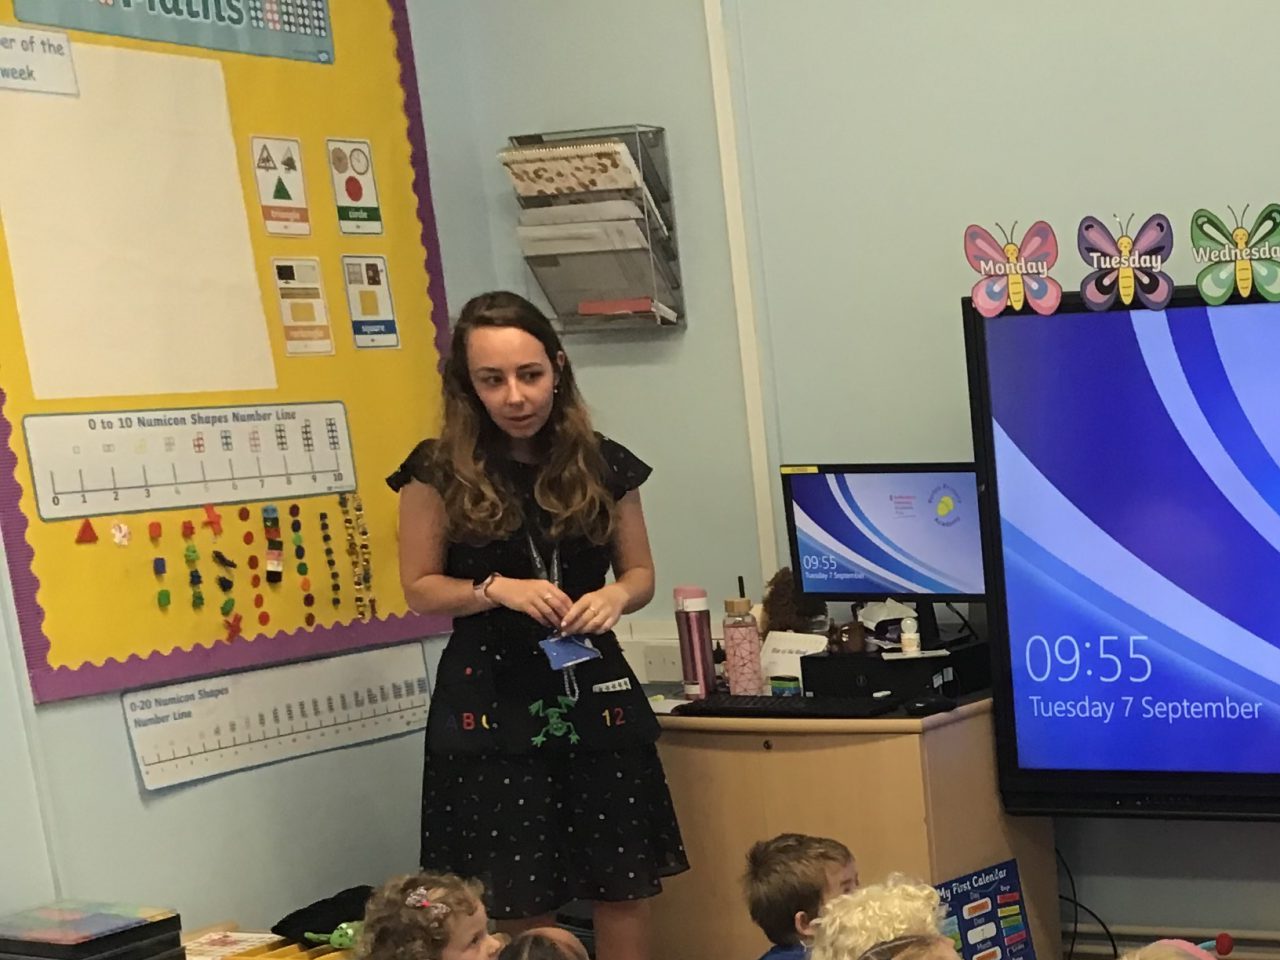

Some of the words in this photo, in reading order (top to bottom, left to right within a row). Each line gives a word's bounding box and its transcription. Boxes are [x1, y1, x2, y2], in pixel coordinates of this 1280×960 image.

[21, 36, 36, 52] of
[40, 38, 65, 56] the
[980, 257, 1048, 277] Monday
[1090, 252, 1162, 272] Tuesday
[101, 419, 113, 430] to
[118, 417, 133, 429] 10
[137, 414, 187, 428] Numicon
[191, 412, 228, 426] Shapes
[232, 409, 272, 422] Number
[276, 408, 297, 421] Line
[52, 495, 60, 506] 0
[81, 494, 87, 504] 1
[113, 491, 119, 501] 2
[144, 489, 151, 499] 3
[332, 472, 343, 482] 10
[803, 555, 837, 570] 09:55
[1025, 635, 1153, 683] 09:55
[198, 686, 230, 701] Shapes
[133, 714, 170, 728] Number
[172, 709, 193, 722] Line
[1029, 696, 1115, 723] Tuesday
[1123, 696, 1133, 716] 7
[1142, 696, 1262, 723] September
[952, 881, 971, 895] First
[972, 868, 1007, 887] Calendar
